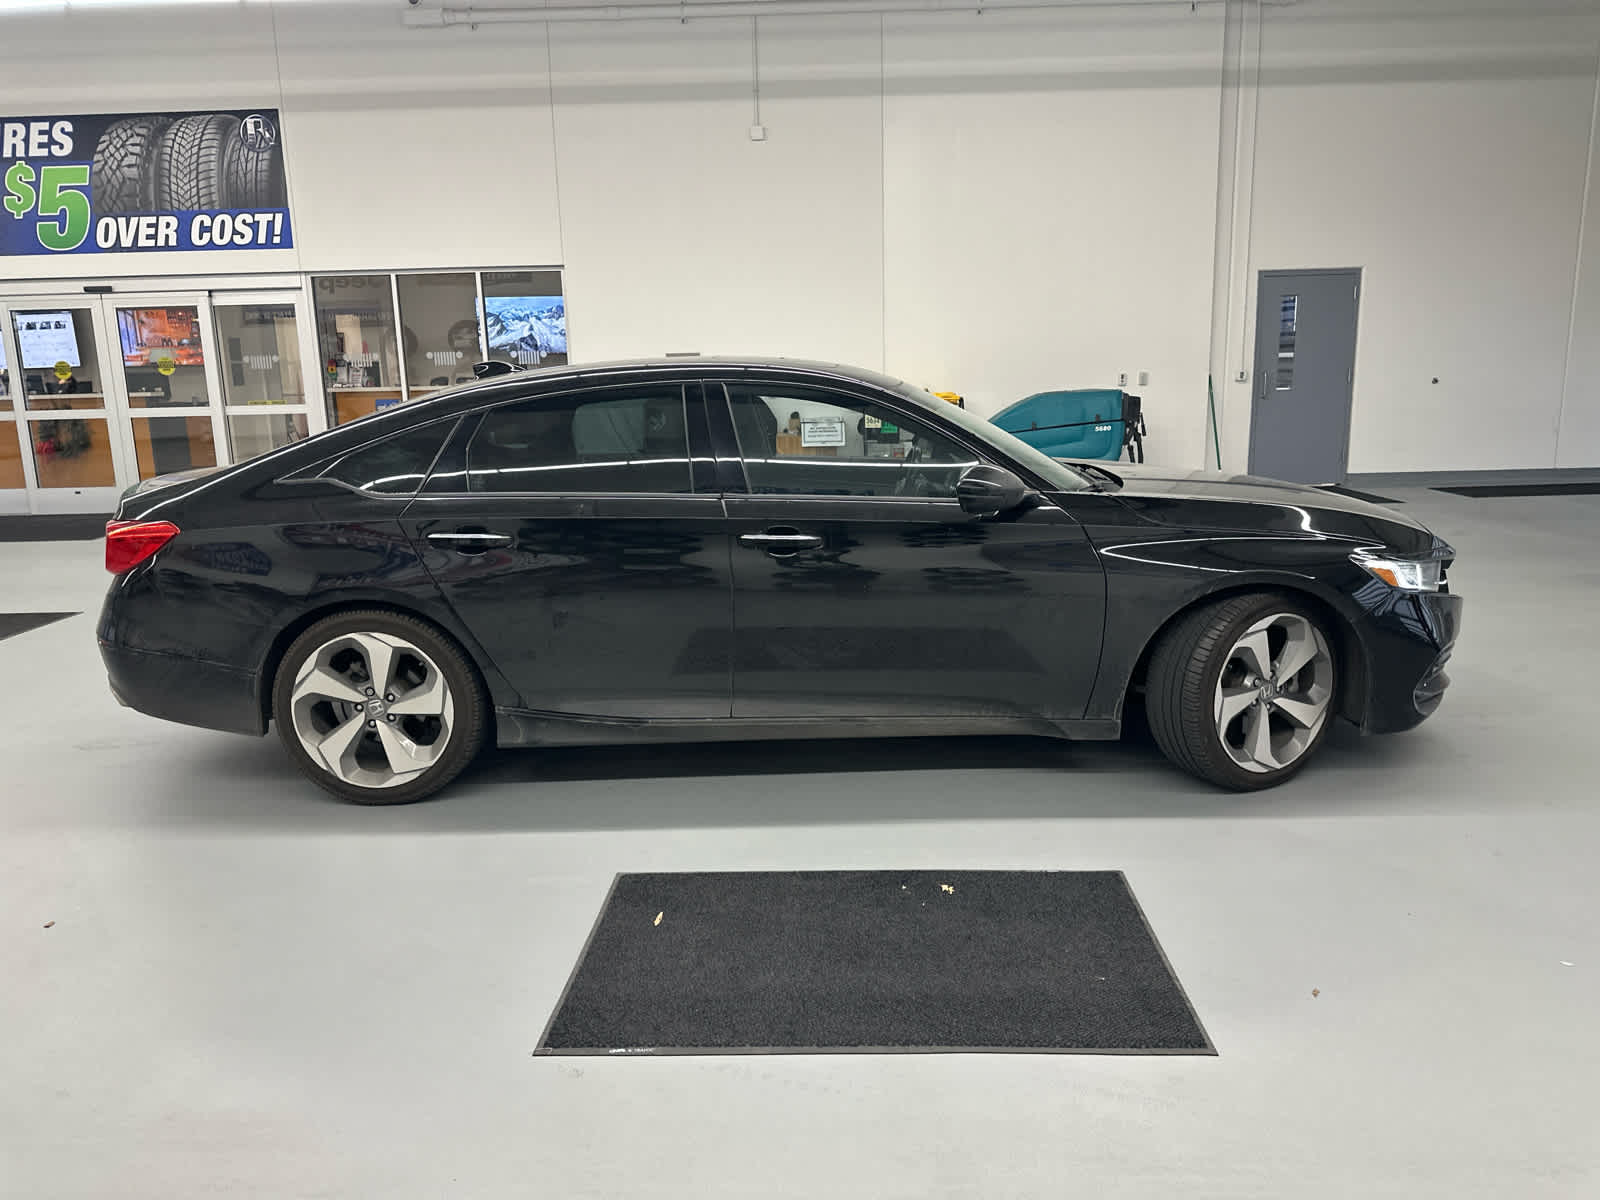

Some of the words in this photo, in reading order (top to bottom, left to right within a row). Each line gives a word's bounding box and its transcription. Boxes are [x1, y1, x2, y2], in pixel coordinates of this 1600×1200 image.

[2, 120, 74, 158] RES
[96, 215, 178, 248] OVER
[190, 212, 283, 246] COST!
